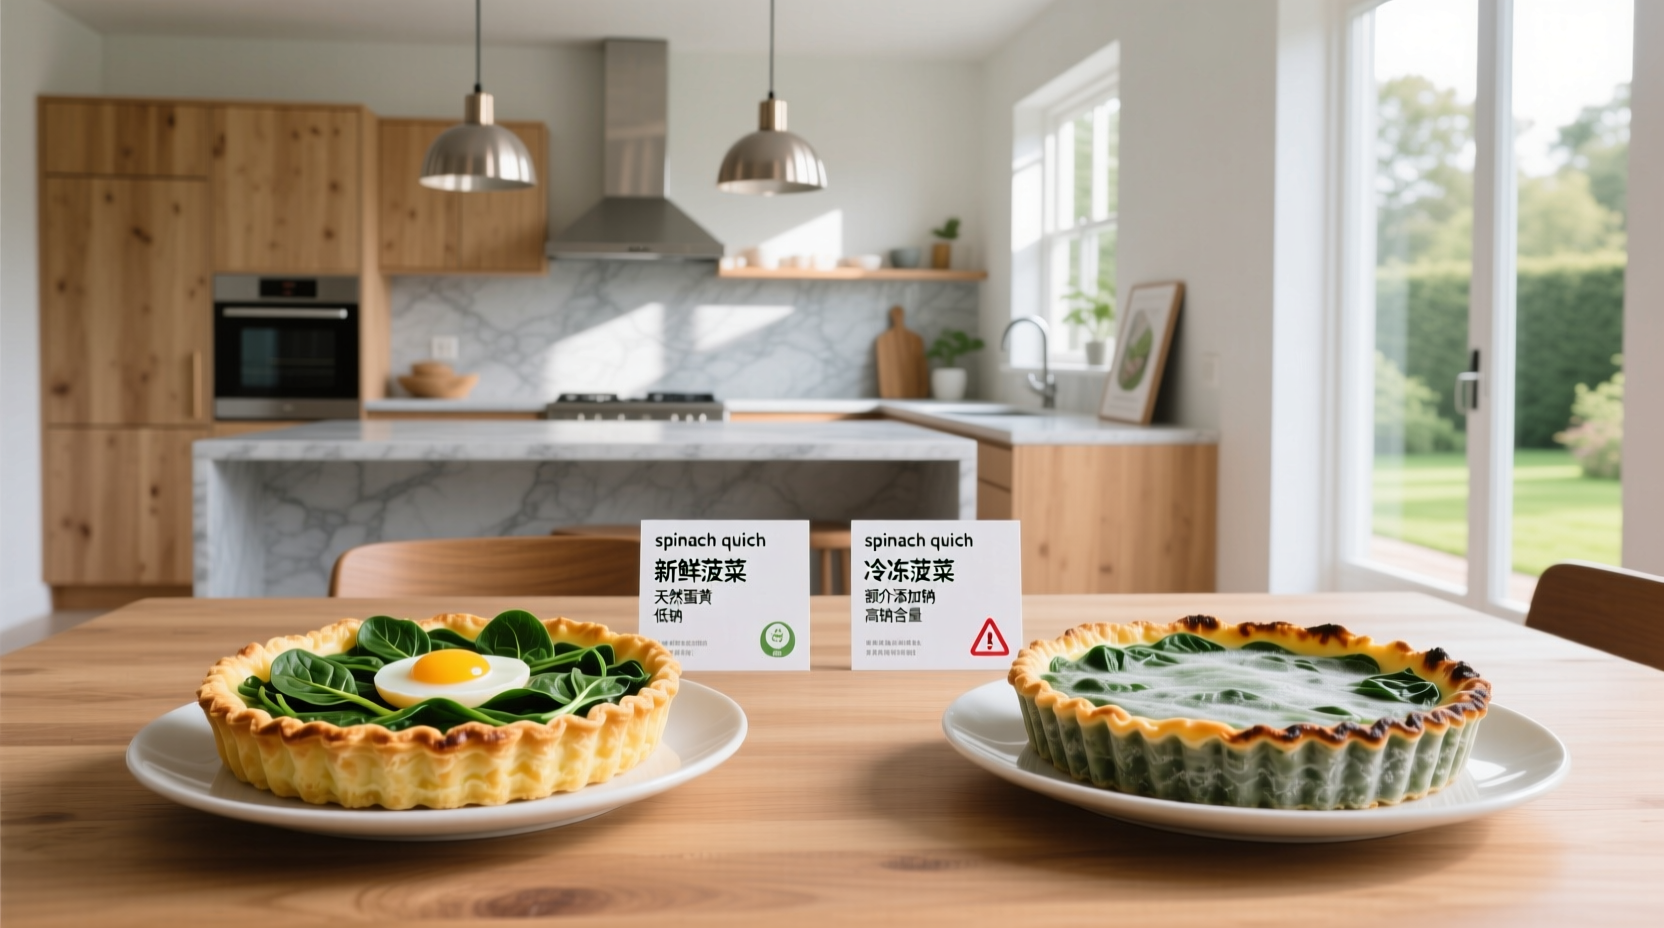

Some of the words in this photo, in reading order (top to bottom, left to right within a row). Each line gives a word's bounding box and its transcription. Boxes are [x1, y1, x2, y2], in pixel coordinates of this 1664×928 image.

[655, 532, 717, 551] spinach
[721, 532, 766, 551] quich
[864, 532, 926, 551] spinach
[930, 532, 974, 551] quich
[654, 558, 747, 583] 新鲜菠菜
[864, 557, 955, 583] 冷冻菠菜
